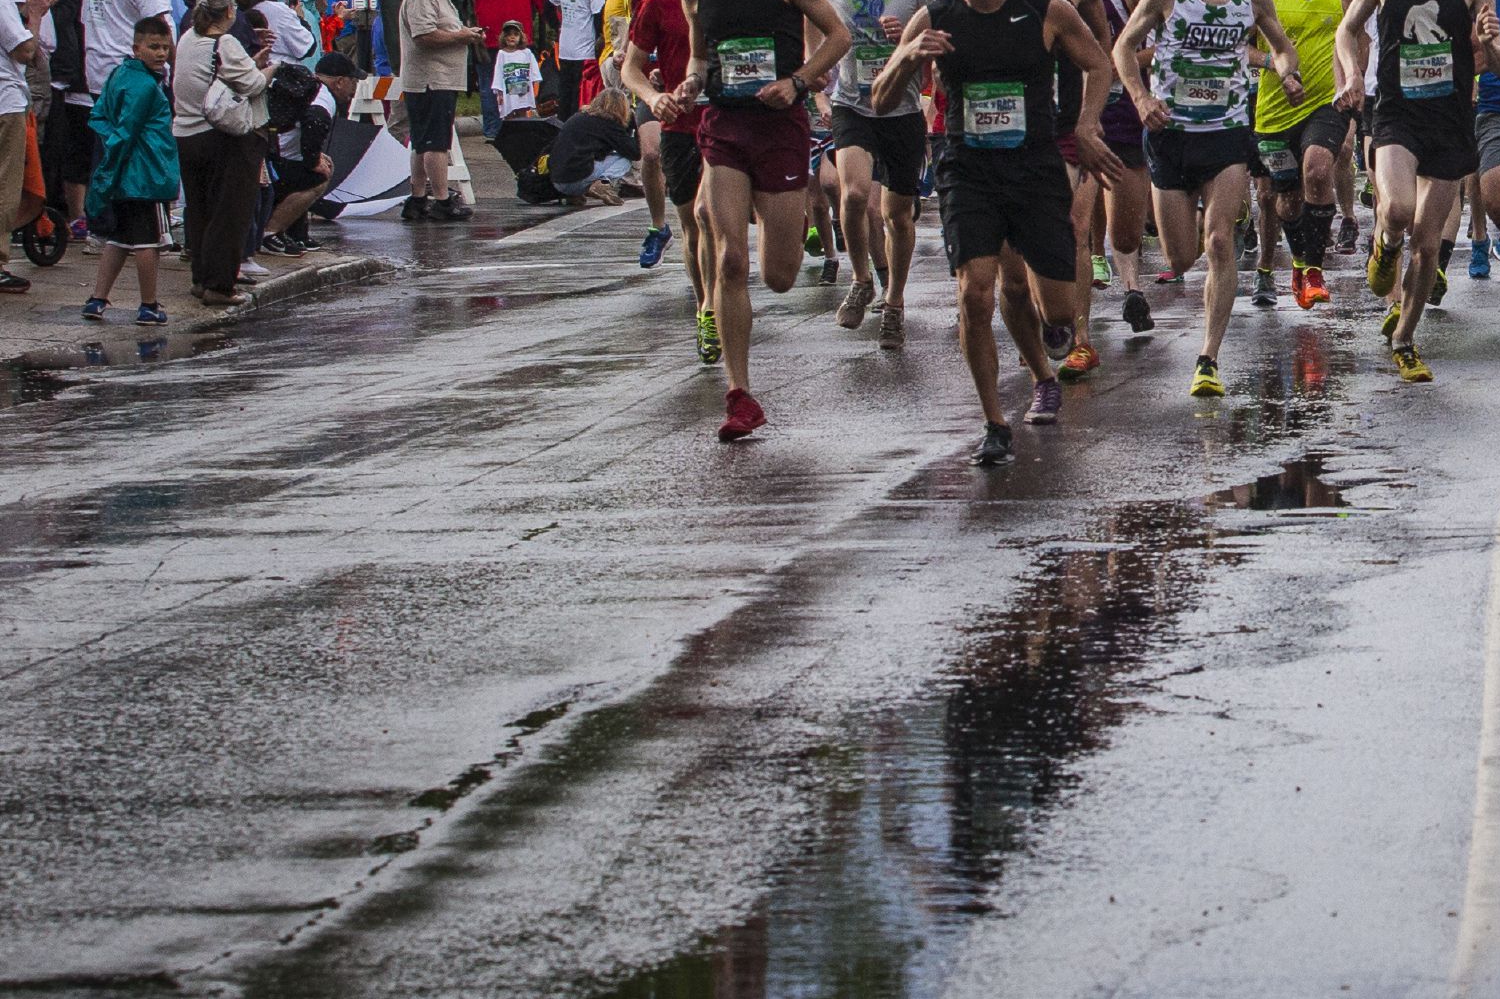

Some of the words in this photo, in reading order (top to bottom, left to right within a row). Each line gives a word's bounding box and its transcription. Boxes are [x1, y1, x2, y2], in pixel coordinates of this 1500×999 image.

[1413, 67, 1442, 78] 1794
[1188, 88, 1219, 100] 2636
[975, 112, 1011, 125] 2575
